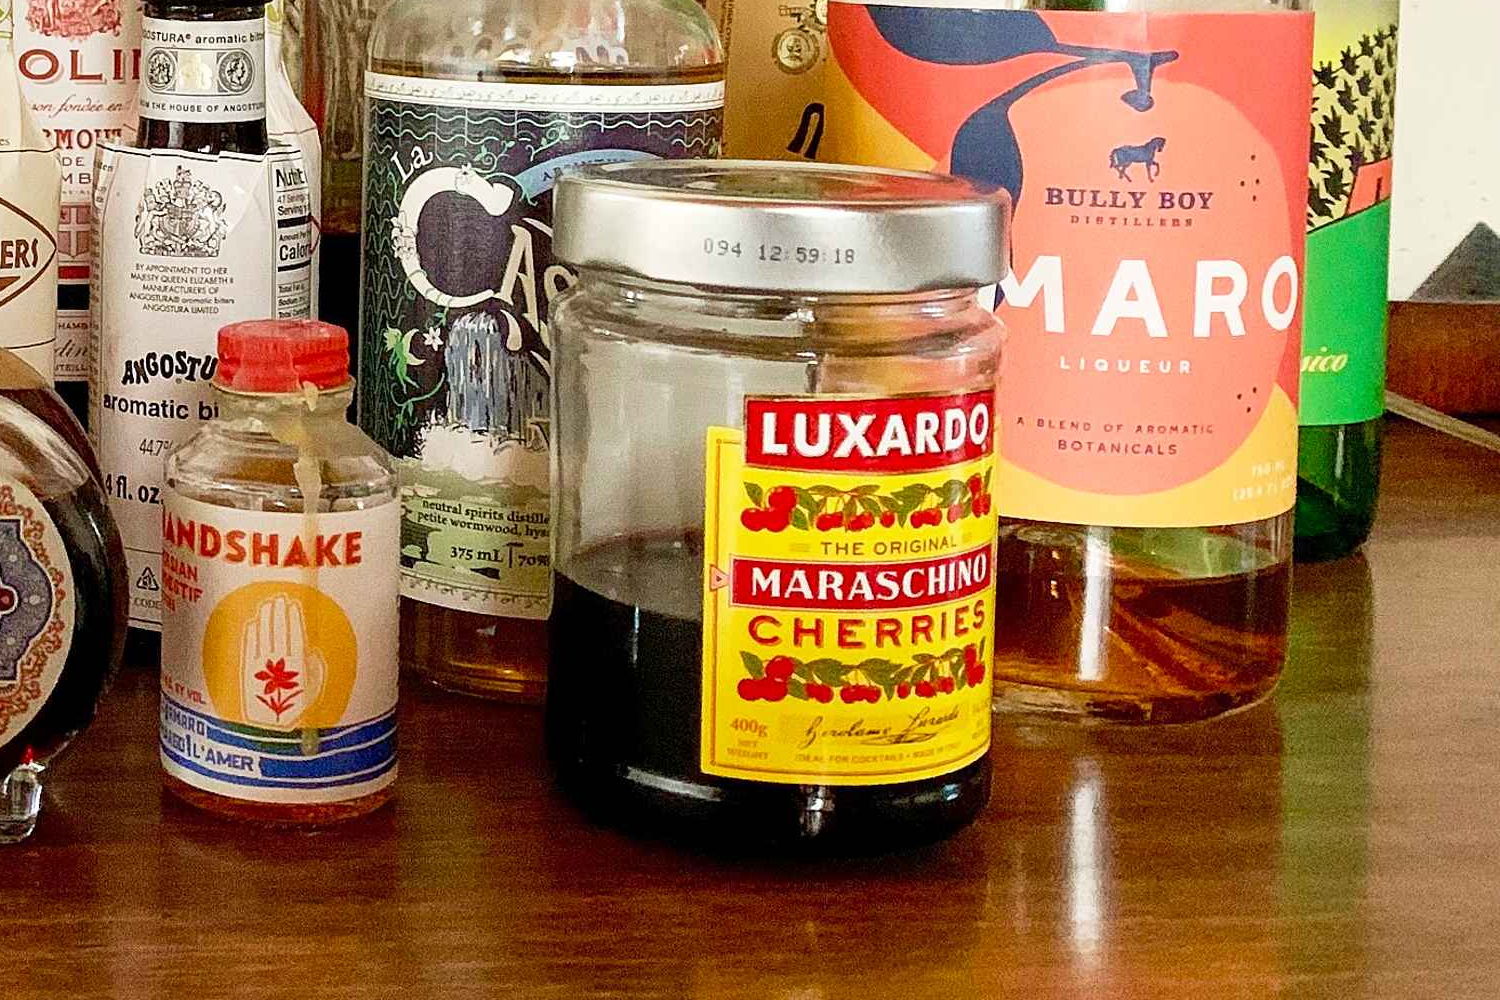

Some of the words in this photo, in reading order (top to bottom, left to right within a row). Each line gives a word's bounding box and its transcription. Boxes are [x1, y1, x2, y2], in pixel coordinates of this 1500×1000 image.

[195, 31, 247, 45] aromatic
[169, 102, 202, 112] HOUSE
[206, 103, 219, 112] OF
[61, 156, 85, 167] DE
[390, 142, 434, 184] La
[1045, 187, 1147, 209] BULLY
[1158, 191, 1215, 210] BOY
[1070, 214, 1194, 228] DISTILLERS
[703, 238, 742, 259] 094
[758, 245, 856, 264] 12:59:18
[130, 272, 159, 281] MAJESTY
[160, 275, 188, 284] QUEEN
[190, 276, 228, 285] ELIZABETH
[146, 264, 198, 274] APPOINTMENT
[201, 266, 212, 275] TO
[213, 267, 228, 275] HER
[142, 283, 206, 294] MANUFACTURERS
[208, 286, 220, 295] OF
[142, 303, 190, 313] ANGOSTURA
[191, 306, 219, 314] LIMITED
[121, 350, 219, 385] ANGOSTU
[1059, 355, 1191, 374] LIQUEUR
[103, 394, 190, 420] aromatic
[762, 402, 990, 458] LUXARDO
[1016, 416, 1025, 427] A
[1036, 418, 1092, 433] BLEND
[1103, 422, 1124, 433] OF
[1135, 424, 1214, 435] AROMATIC
[1058, 439, 1178, 456] BOTANICALS
[116, 475, 133, 501] fl.
[138, 485, 164, 504] oz.
[422, 498, 463, 515] neutral
[464, 504, 504, 520] spirits
[416, 511, 448, 528] petite
[450, 518, 522, 538] wormwood,
[449, 546, 473, 561] 375
[477, 548, 503, 562] mL
[820, 541, 864, 555] THE
[873, 536, 957, 555] ORIGINAL
[751, 552, 987, 601] MARASCHINO
[748, 600, 986, 649] CHERRIES
[729, 717, 769, 738] 400g
[193, 742, 254, 772] L'AMER
